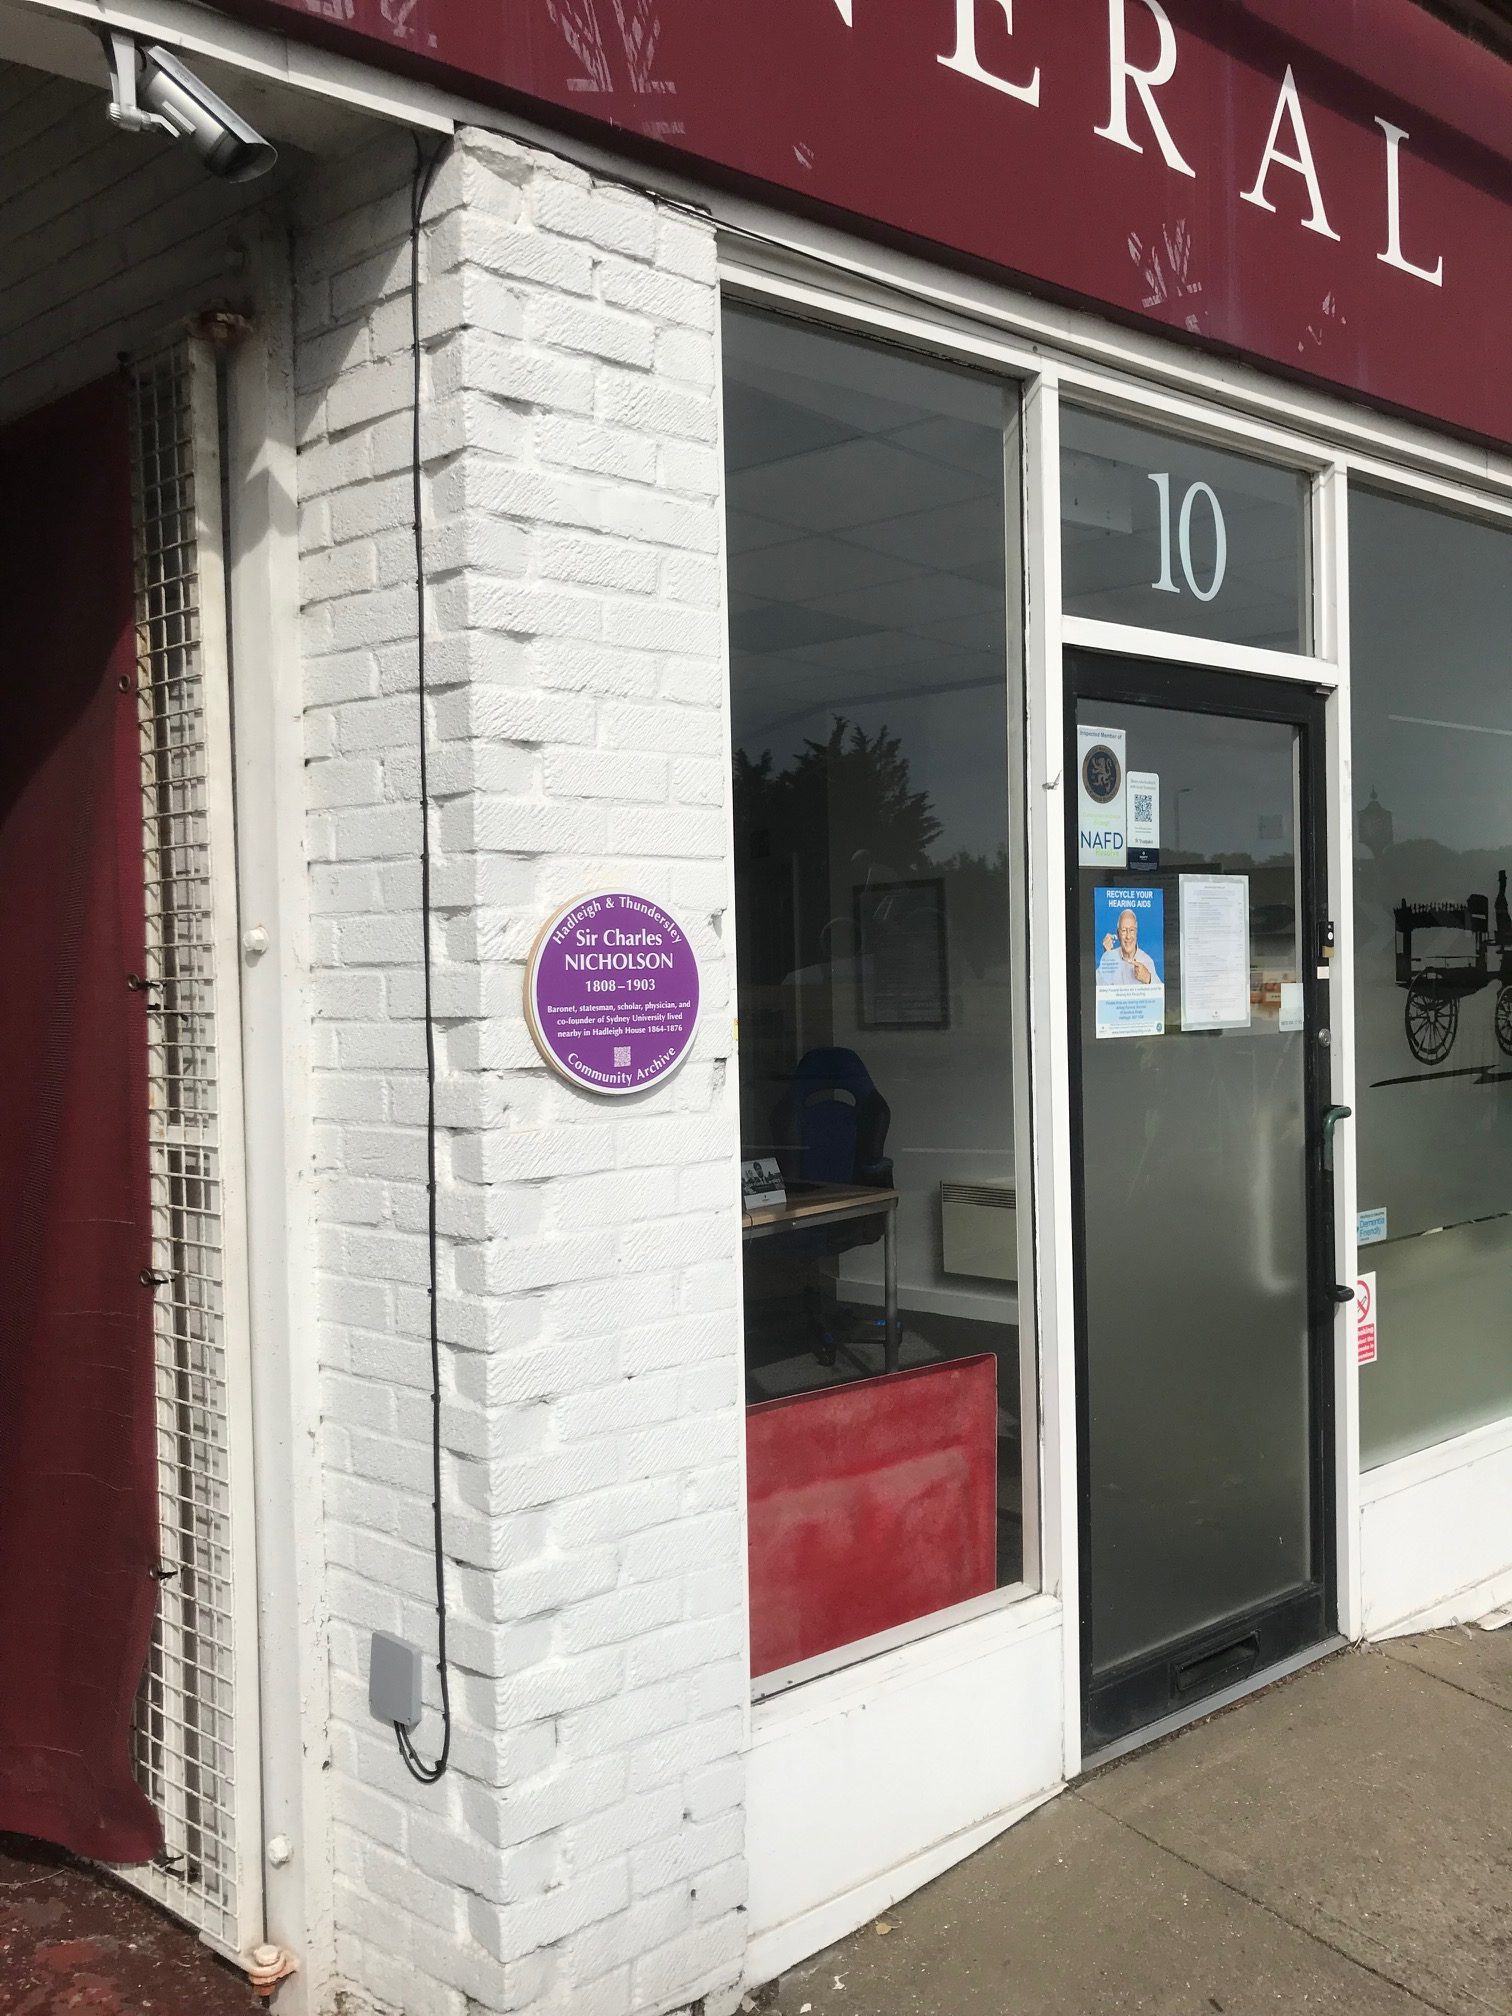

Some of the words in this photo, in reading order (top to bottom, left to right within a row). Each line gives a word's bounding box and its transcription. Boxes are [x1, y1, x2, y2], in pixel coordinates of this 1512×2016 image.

[1148, 473, 1226, 601] 10
[1080, 831, 1124, 850] NAFD
[1106, 890, 1134, 898] RECYCLE
[1108, 900, 1136, 908] HEARING
[1137, 900, 1152, 908] AIDS
[552, 899, 602, 944] Hadleigh
[606, 897, 615, 908] &
[619, 896, 682, 944] Thundersley
[576, 929, 598, 946] Sir
[603, 928, 662, 946] Charles
[565, 952, 674, 970] NICHOLSON
[548, 1005, 578, 1014] Baronet,
[580, 1004, 616, 1012] statesman,
[618, 1002, 644, 1012] scholar,
[645, 1001, 677, 1011] physician,
[678, 1000, 690, 1008] and
[557, 1016, 596, 1026] co-founder
[598, 1016, 605, 1024] of
[606, 1015, 630, 1024] Sydney
[632, 1014, 666, 1023] University
[668, 1012, 683, 1020] lived
[558, 1030, 582, 1038] nearby
[584, 1028, 590, 1036] in
[592, 1028, 623, 1037] Hadleigh
[625, 1026, 646, 1034] House
[648, 1024, 683, 1033] 1864-1876
[568, 1052, 632, 1086] Community
[636, 1047, 676, 1080] Archive
